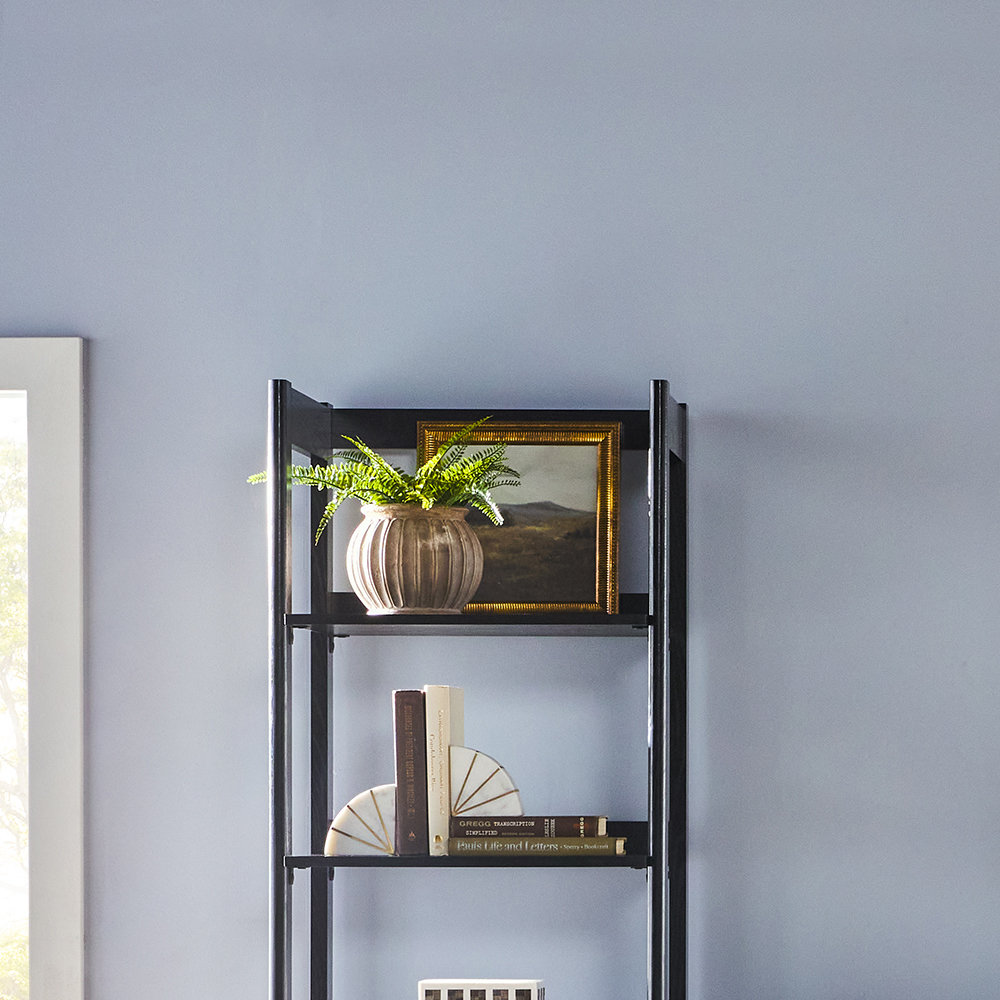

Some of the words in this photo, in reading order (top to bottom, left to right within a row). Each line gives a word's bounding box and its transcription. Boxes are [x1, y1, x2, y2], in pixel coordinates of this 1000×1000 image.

[484, 840, 503, 851] Life
[504, 840, 523, 851] and
[525, 840, 559, 851] Letters
